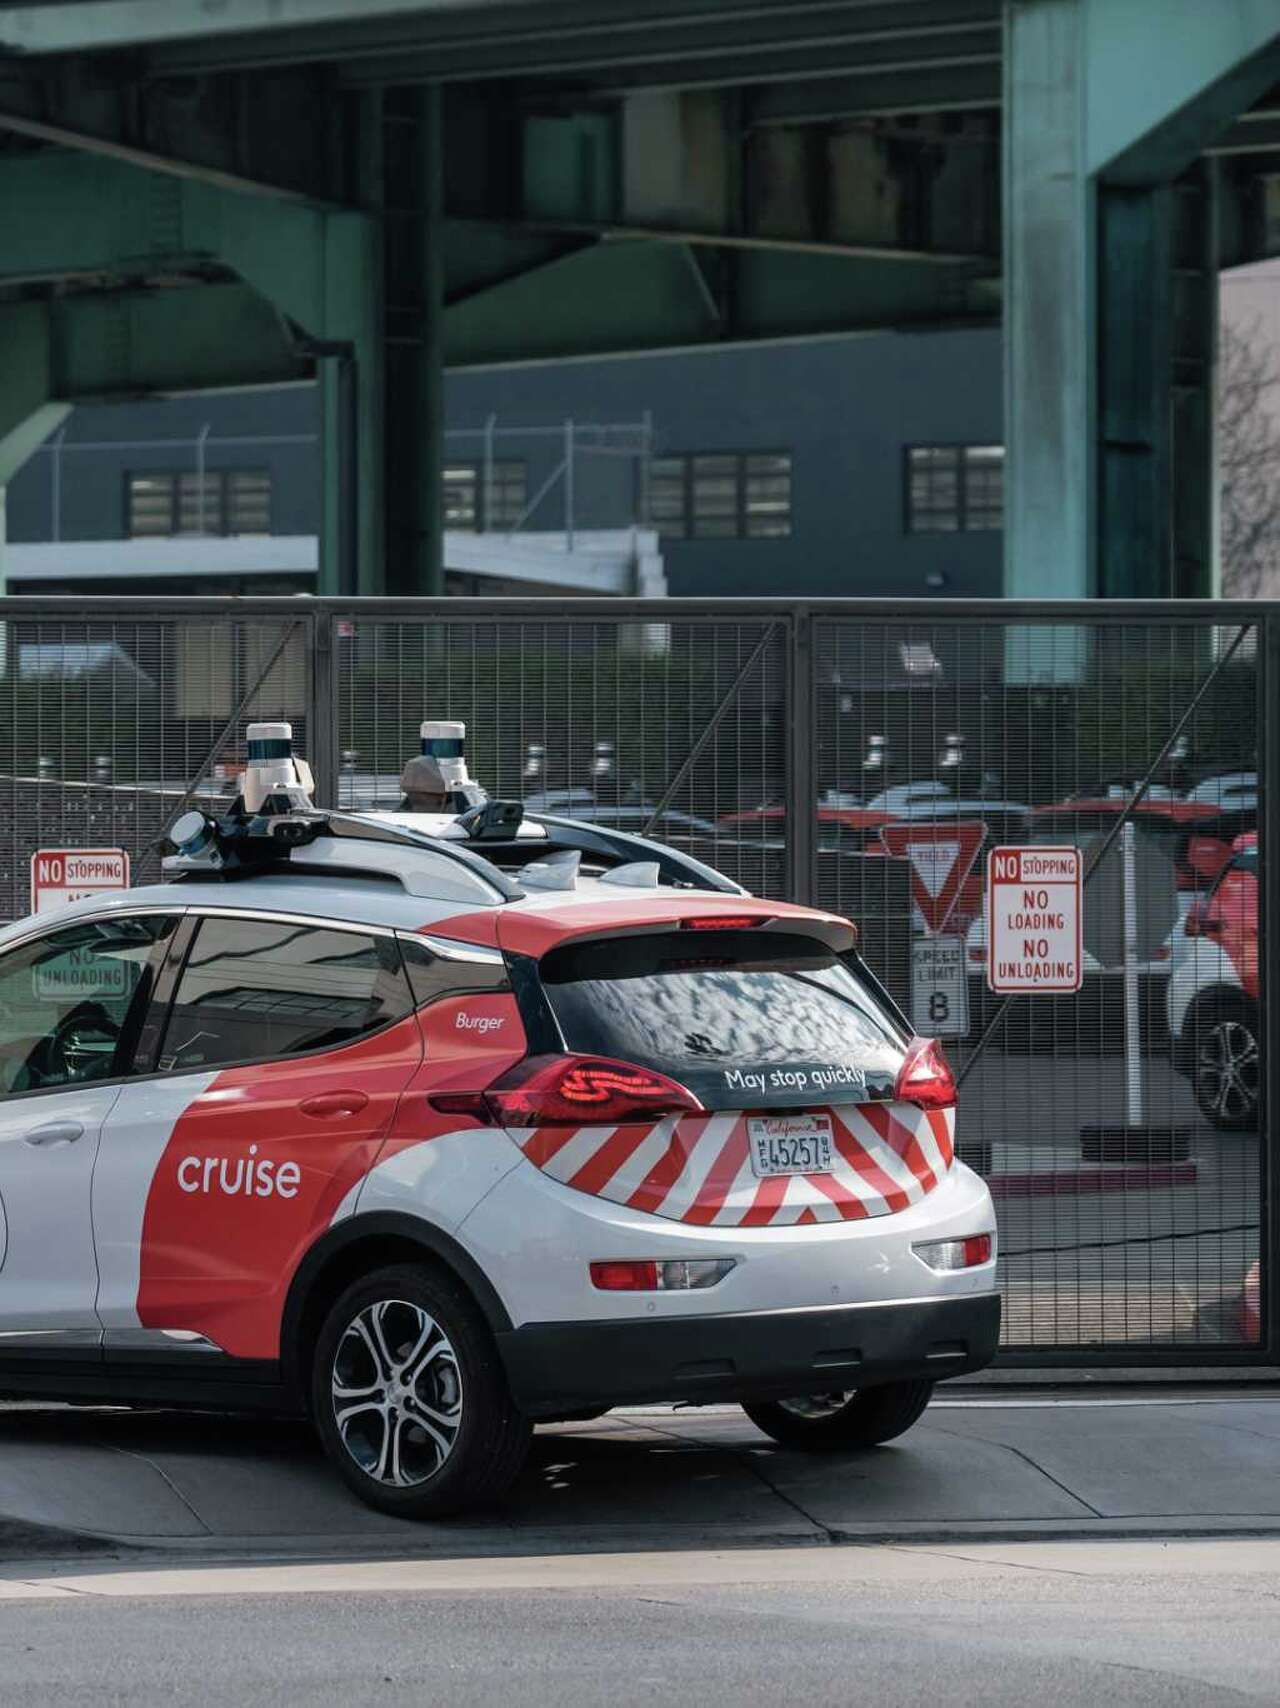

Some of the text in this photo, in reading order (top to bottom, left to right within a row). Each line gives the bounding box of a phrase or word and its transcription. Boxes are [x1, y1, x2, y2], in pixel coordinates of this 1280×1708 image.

[39, 860, 121, 882] NO STOPPING
[995, 857, 1075, 879] NO STOPPING
[1023, 890, 1048, 909] NO
[1008, 914, 1064, 930] LOADING
[1023, 939, 1048, 958] NO
[999, 963, 1074, 979] UNLOADING
[929, 991, 949, 1022] 8
[455, 1012, 504, 1034] Burger
[725, 1065, 866, 1094] May stop quickly
[769, 1137, 819, 1166] 45257
[177, 1145, 301, 1198] cruise
